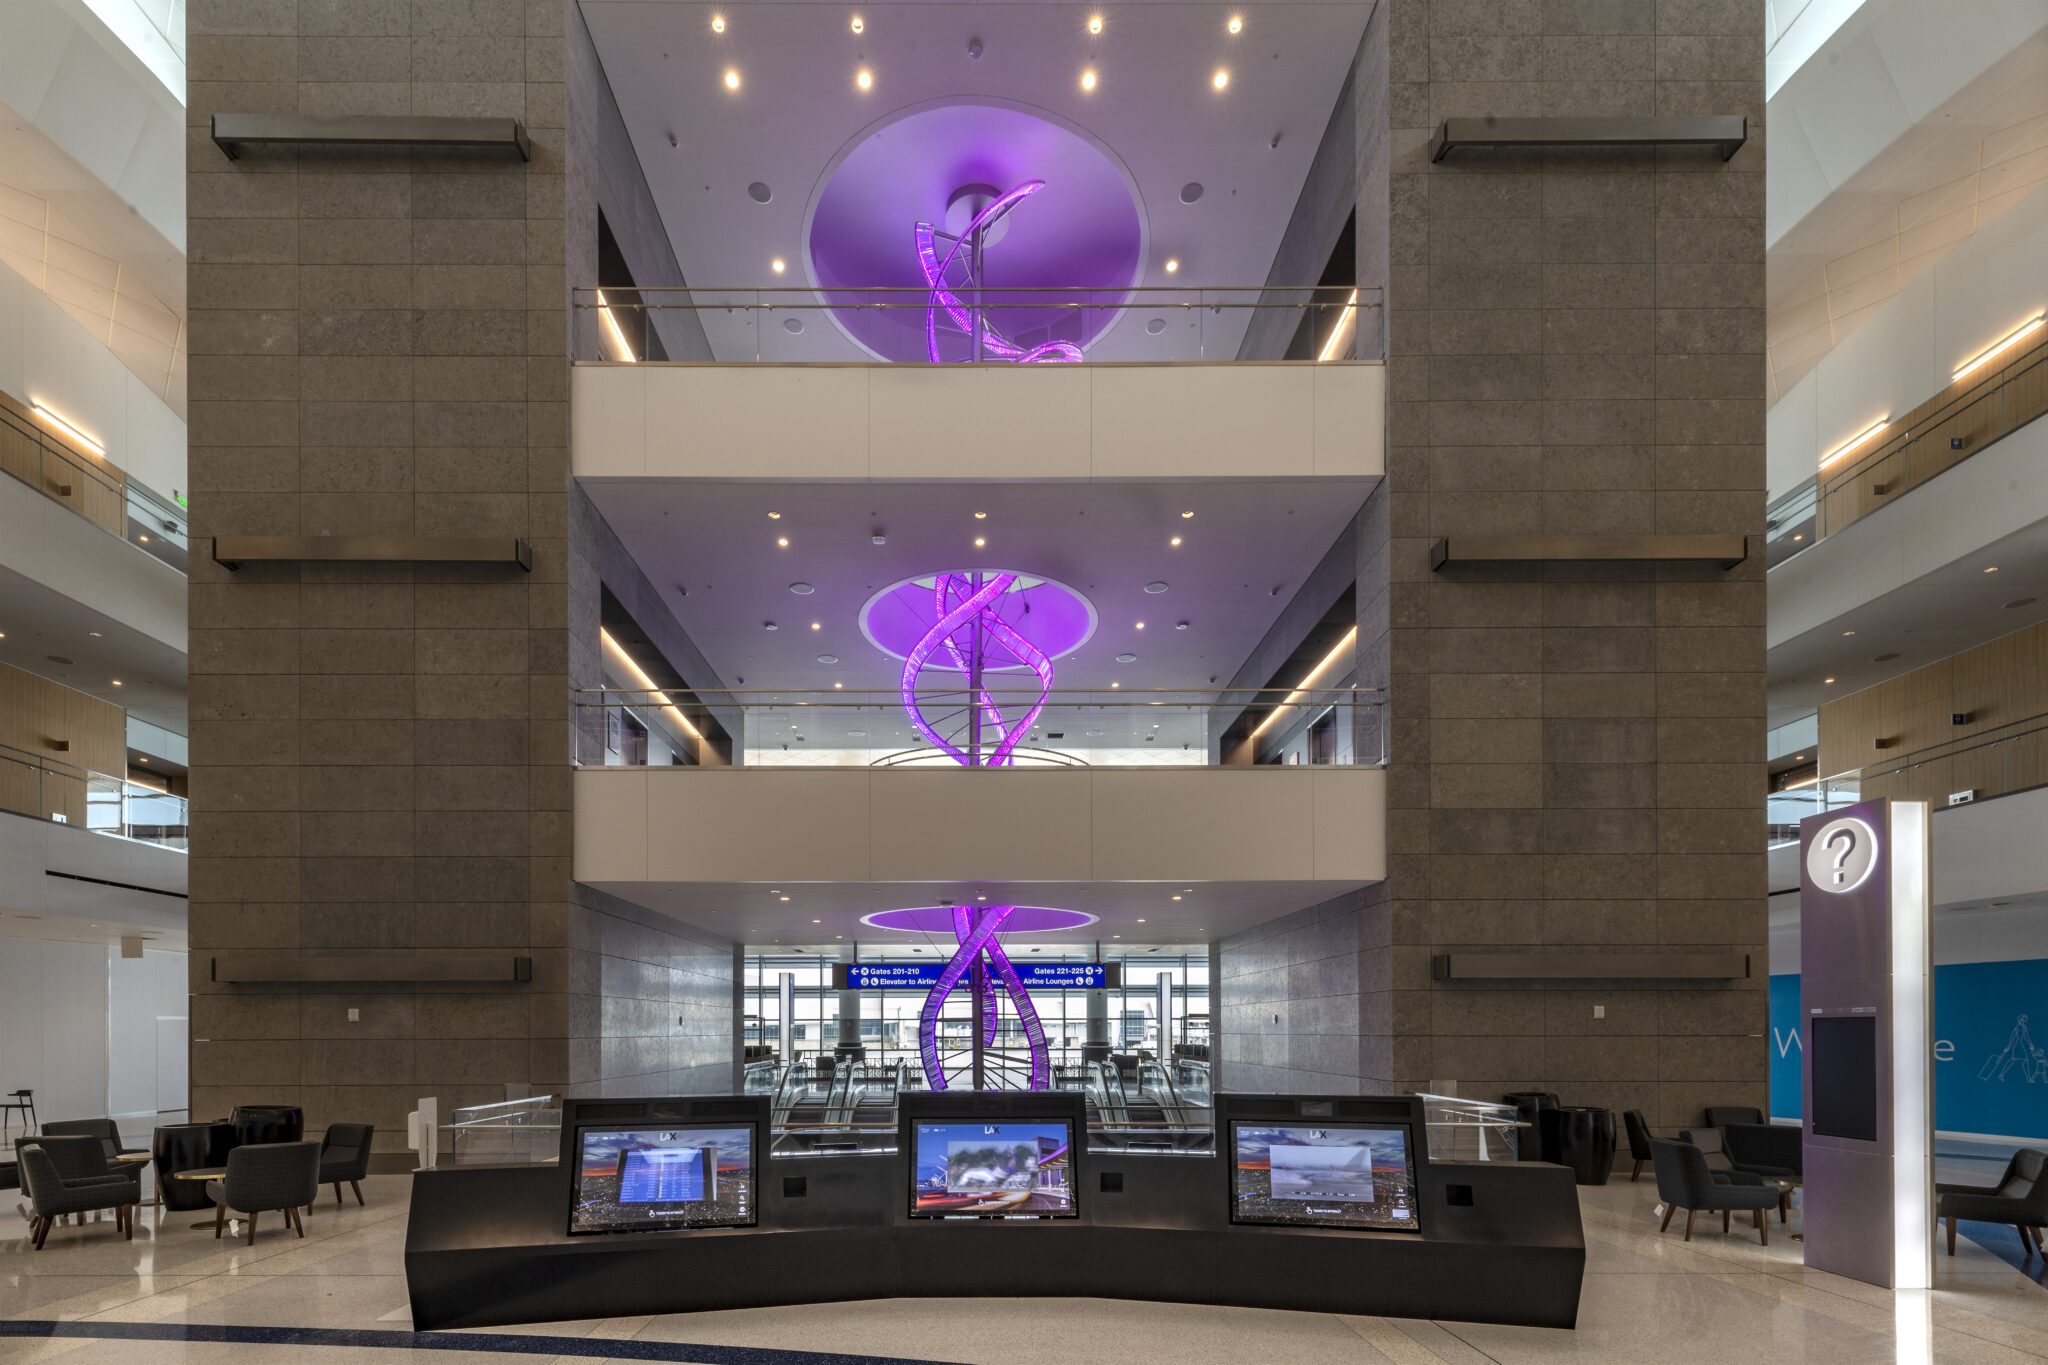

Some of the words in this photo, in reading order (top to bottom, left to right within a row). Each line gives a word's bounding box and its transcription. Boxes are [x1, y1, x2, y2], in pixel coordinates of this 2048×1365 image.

[1045, 978, 1074, 986] Lounges
[984, 1126, 1000, 1134] LAX
[660, 1132, 677, 1141] LAX
[1310, 1130, 1327, 1139] LAX
